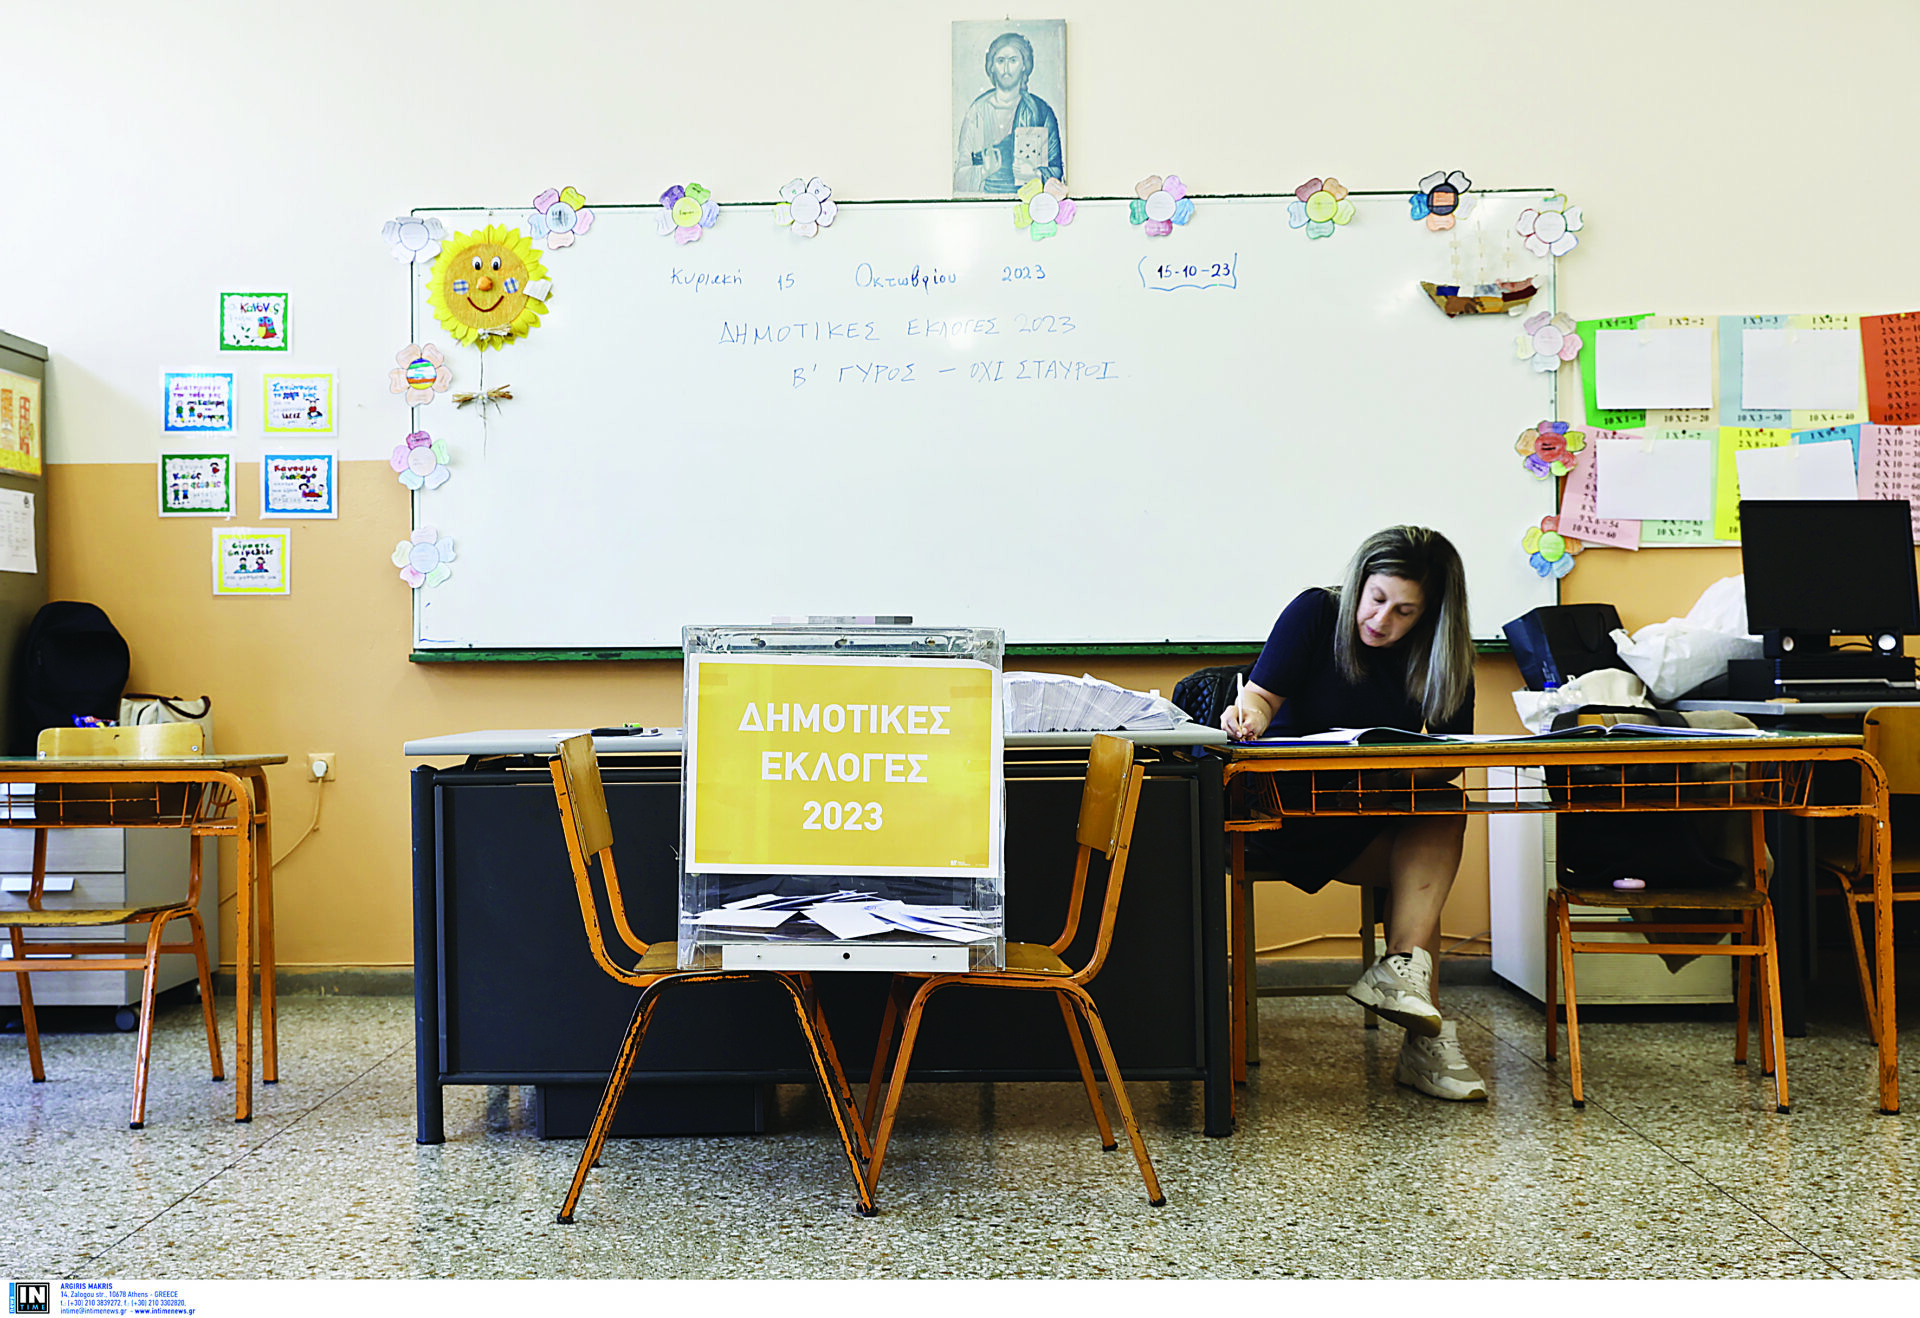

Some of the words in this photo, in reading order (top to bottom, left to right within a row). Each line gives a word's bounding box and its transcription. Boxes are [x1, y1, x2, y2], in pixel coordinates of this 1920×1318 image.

[777, 273, 794, 291] 15
[1001, 264, 1046, 282] 2023
[718, 320, 882, 346] ΔΗΜΟΤΙΚΕΣ
[907, 317, 1002, 337] ΕΚΛΟΓΕΣ
[1012, 315, 1077, 335] 2023
[838, 363, 917, 385] ΓΥΡΟΣ
[738, 702, 951, 736] ΔΗΜΟΤΙΚΕΣ
[761, 751, 928, 784] ΕΚΛΟΓΕΣ
[802, 801, 884, 831] 2023
